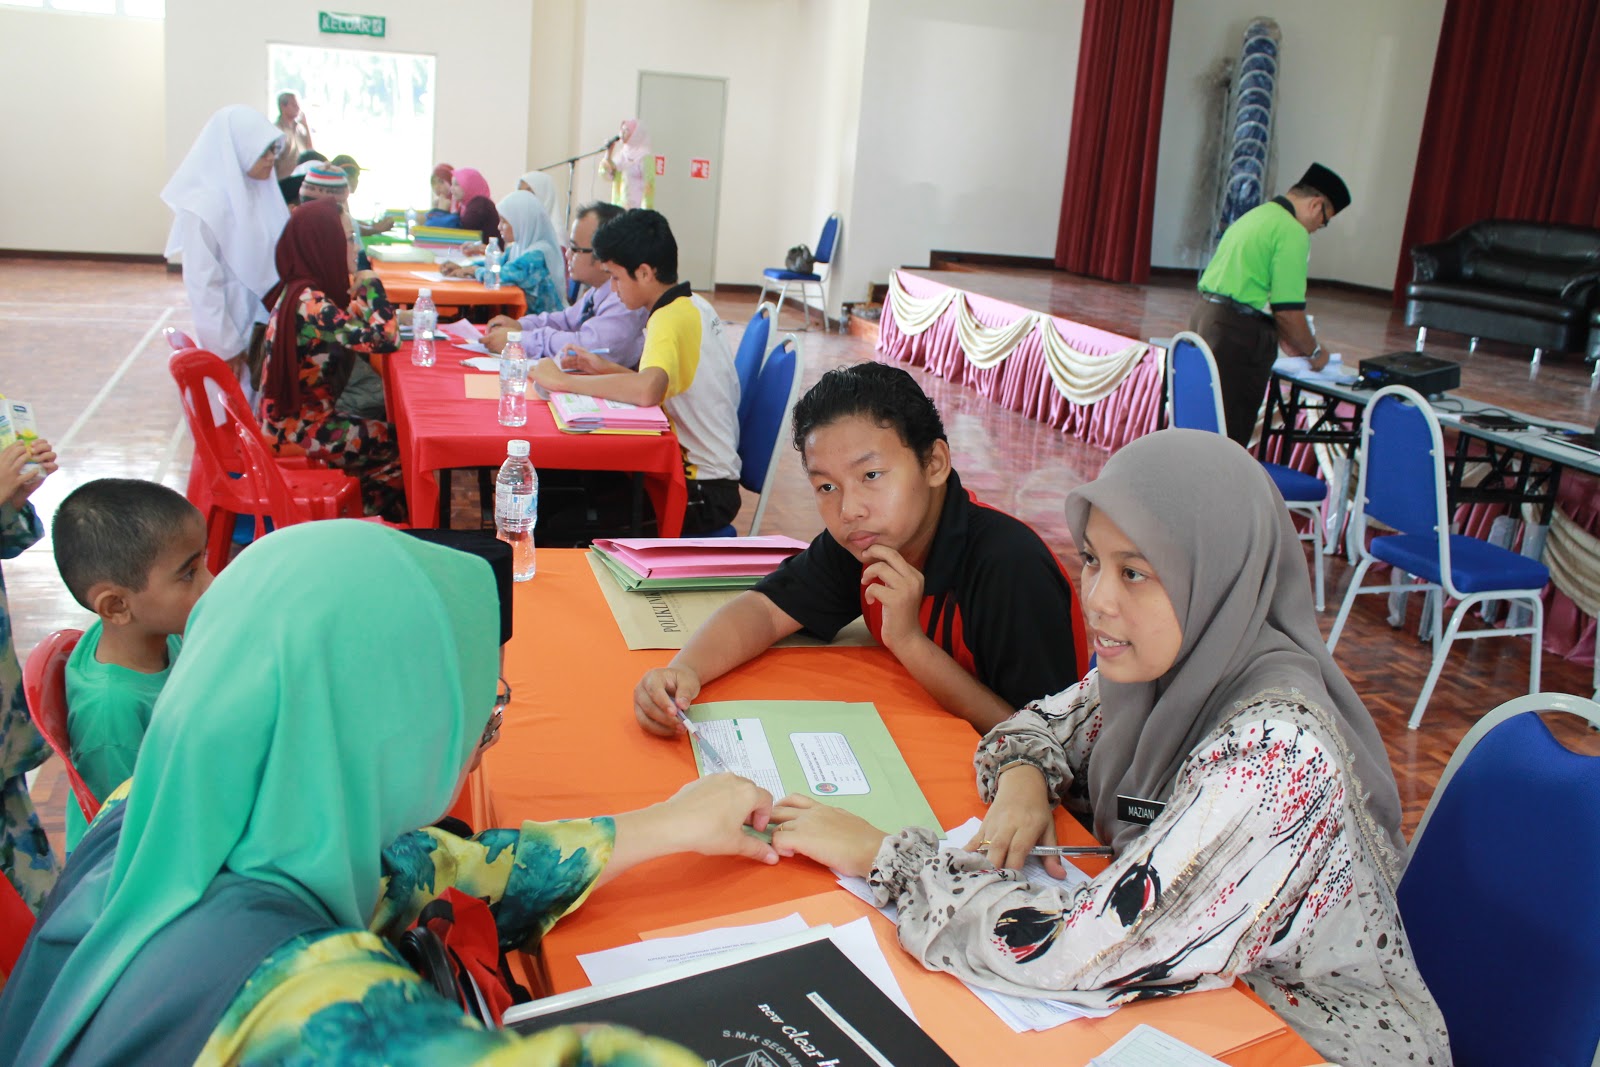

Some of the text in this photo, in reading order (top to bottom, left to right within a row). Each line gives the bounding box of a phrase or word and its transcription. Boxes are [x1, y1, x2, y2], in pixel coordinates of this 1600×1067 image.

[322, 14, 371, 32] KELUAR
[1128, 805, 1155, 819] MAZIANI
[757, 1003, 784, 1023] new
[781, 1025, 825, 1057] clear
